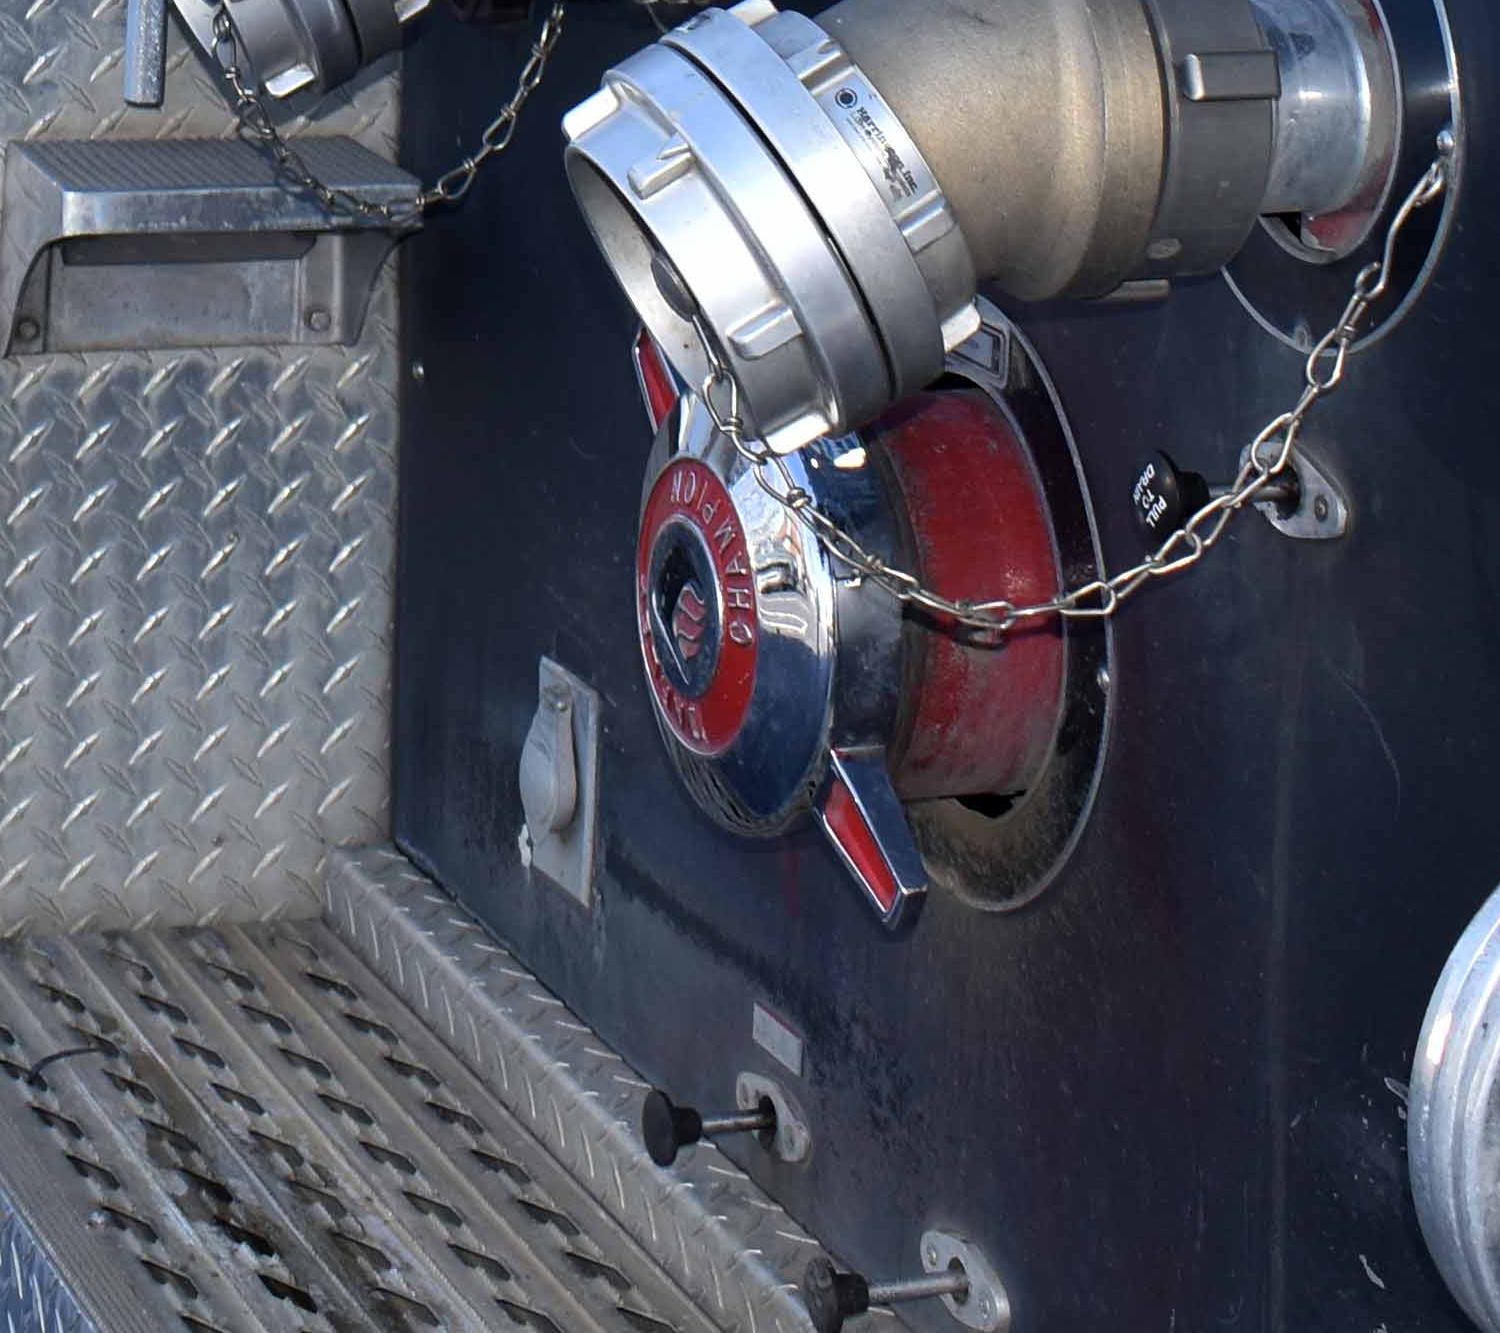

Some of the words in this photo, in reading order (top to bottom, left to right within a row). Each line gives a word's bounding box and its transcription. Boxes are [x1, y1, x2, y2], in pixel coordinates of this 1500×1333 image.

[856, 106, 905, 172] Harrinon
[1141, 488, 1155, 510] TO
[1145, 494, 1168, 528] PULL
[671, 469, 753, 646] CHAMPION
